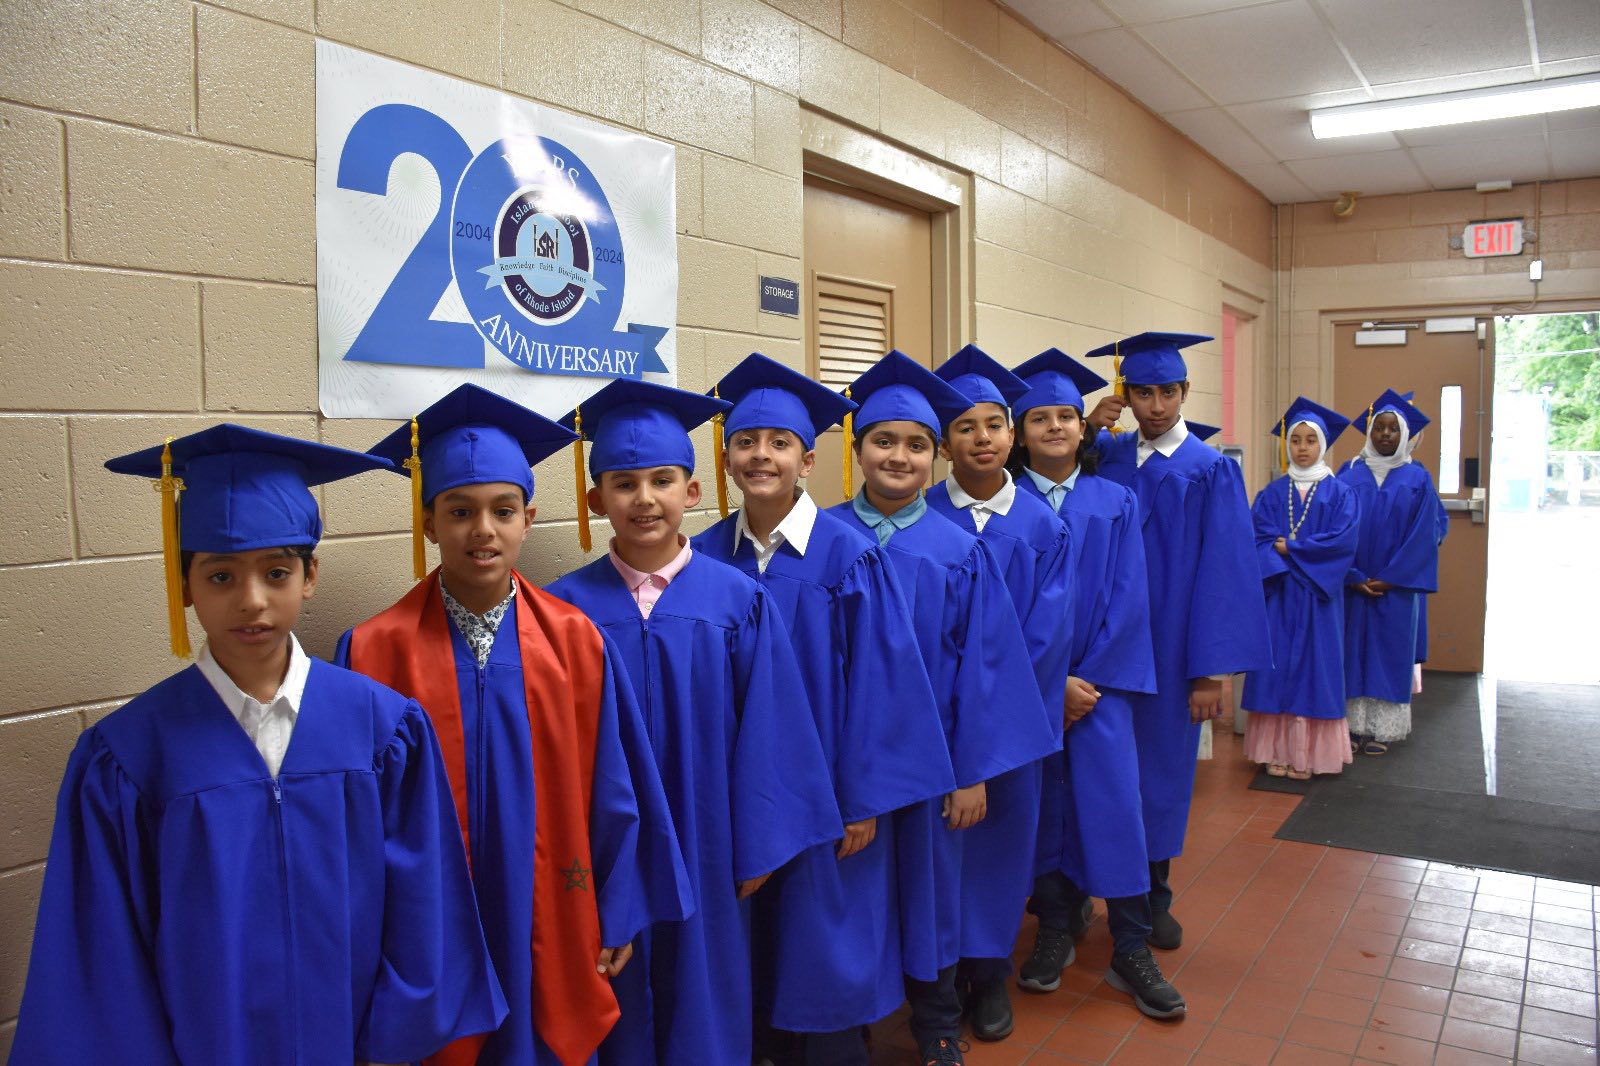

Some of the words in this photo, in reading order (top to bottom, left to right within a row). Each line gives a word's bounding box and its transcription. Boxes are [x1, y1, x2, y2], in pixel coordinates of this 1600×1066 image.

[455, 221, 491, 241] 2004
[1474, 223, 1515, 254] EXIT
[595, 247, 623, 265] 2024
[500, 261, 535, 271] Knowledge
[539, 262, 554, 272] Faith
[515, 284, 528, 297] of
[525, 294, 550, 313] Rhode
[551, 289, 576, 313] Island
[764, 285, 794, 300] STORAGE
[479, 314, 640, 375] ANNIVERSARY
